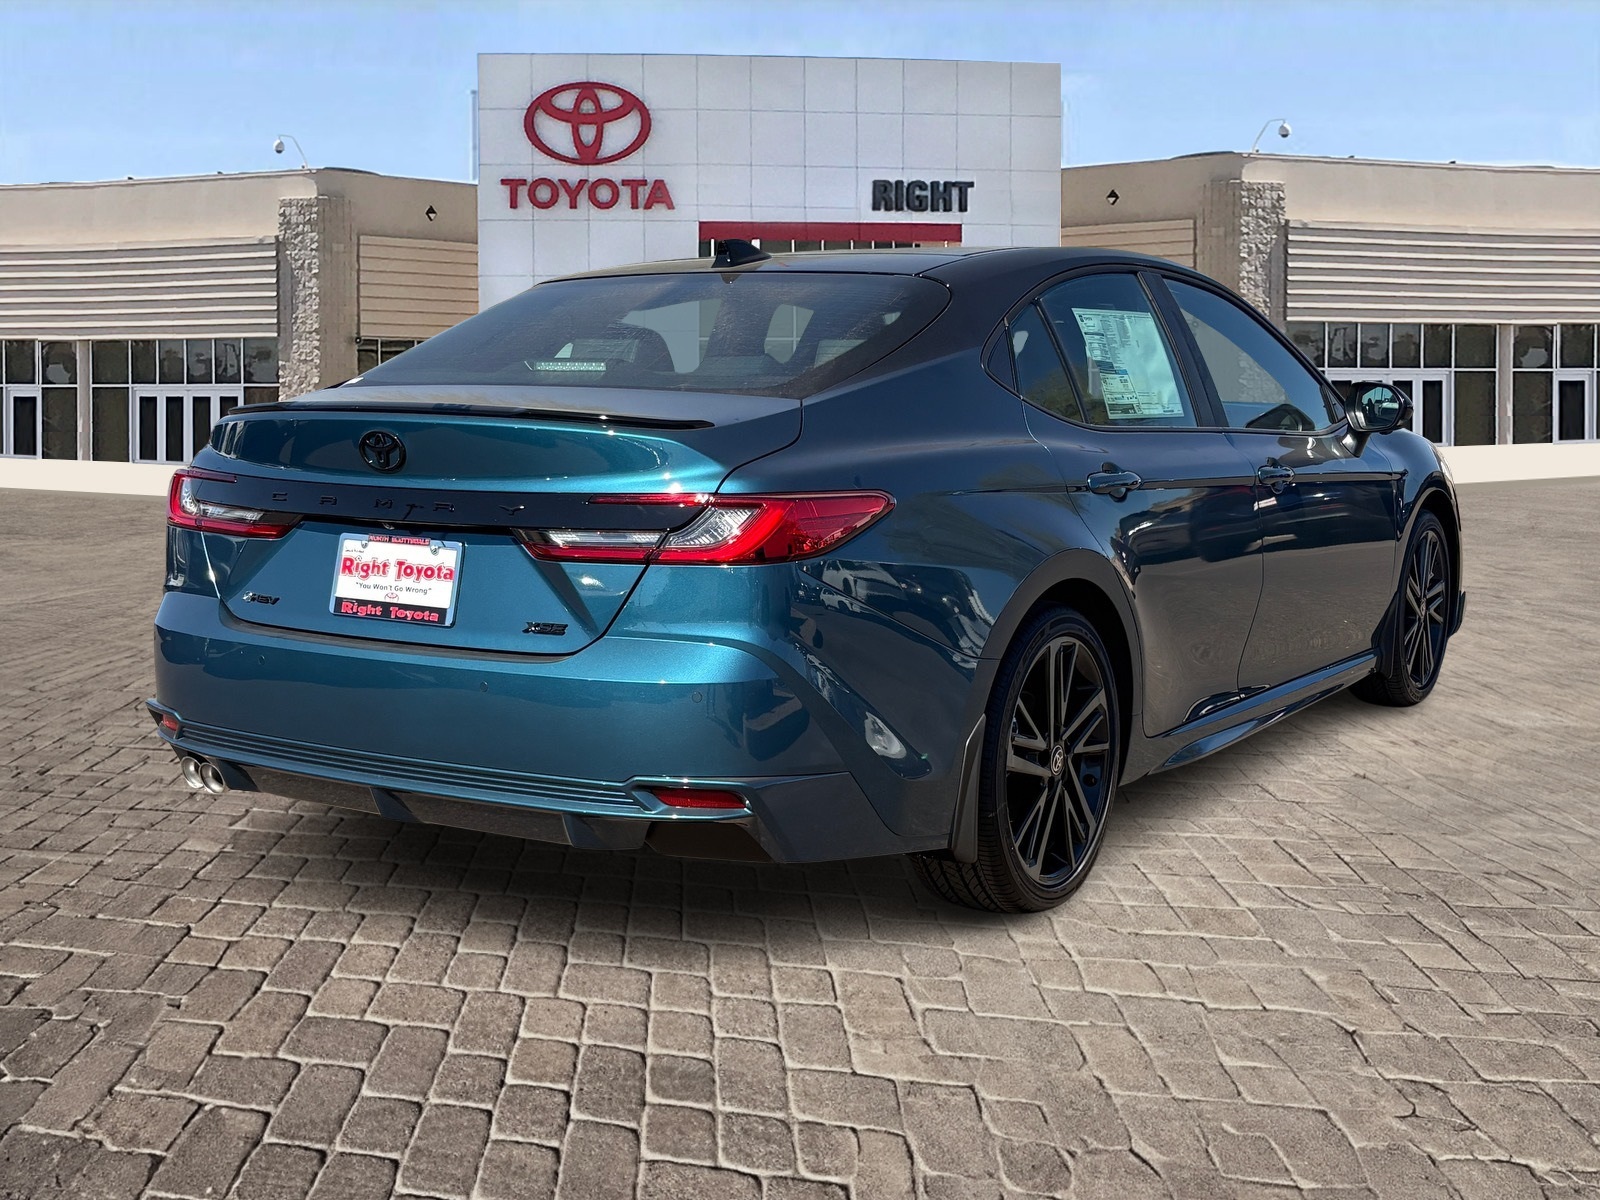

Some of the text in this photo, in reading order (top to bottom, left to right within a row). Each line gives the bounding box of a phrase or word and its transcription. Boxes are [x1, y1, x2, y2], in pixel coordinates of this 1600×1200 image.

[500, 178, 675, 210] TOYOTA
[871, 180, 975, 213] RIGHT
[271, 492, 526, 516] CAMRY
[341, 556, 455, 582] Right Toyota
[341, 601, 439, 622] Right Toyota
[522, 621, 569, 636] XSE
